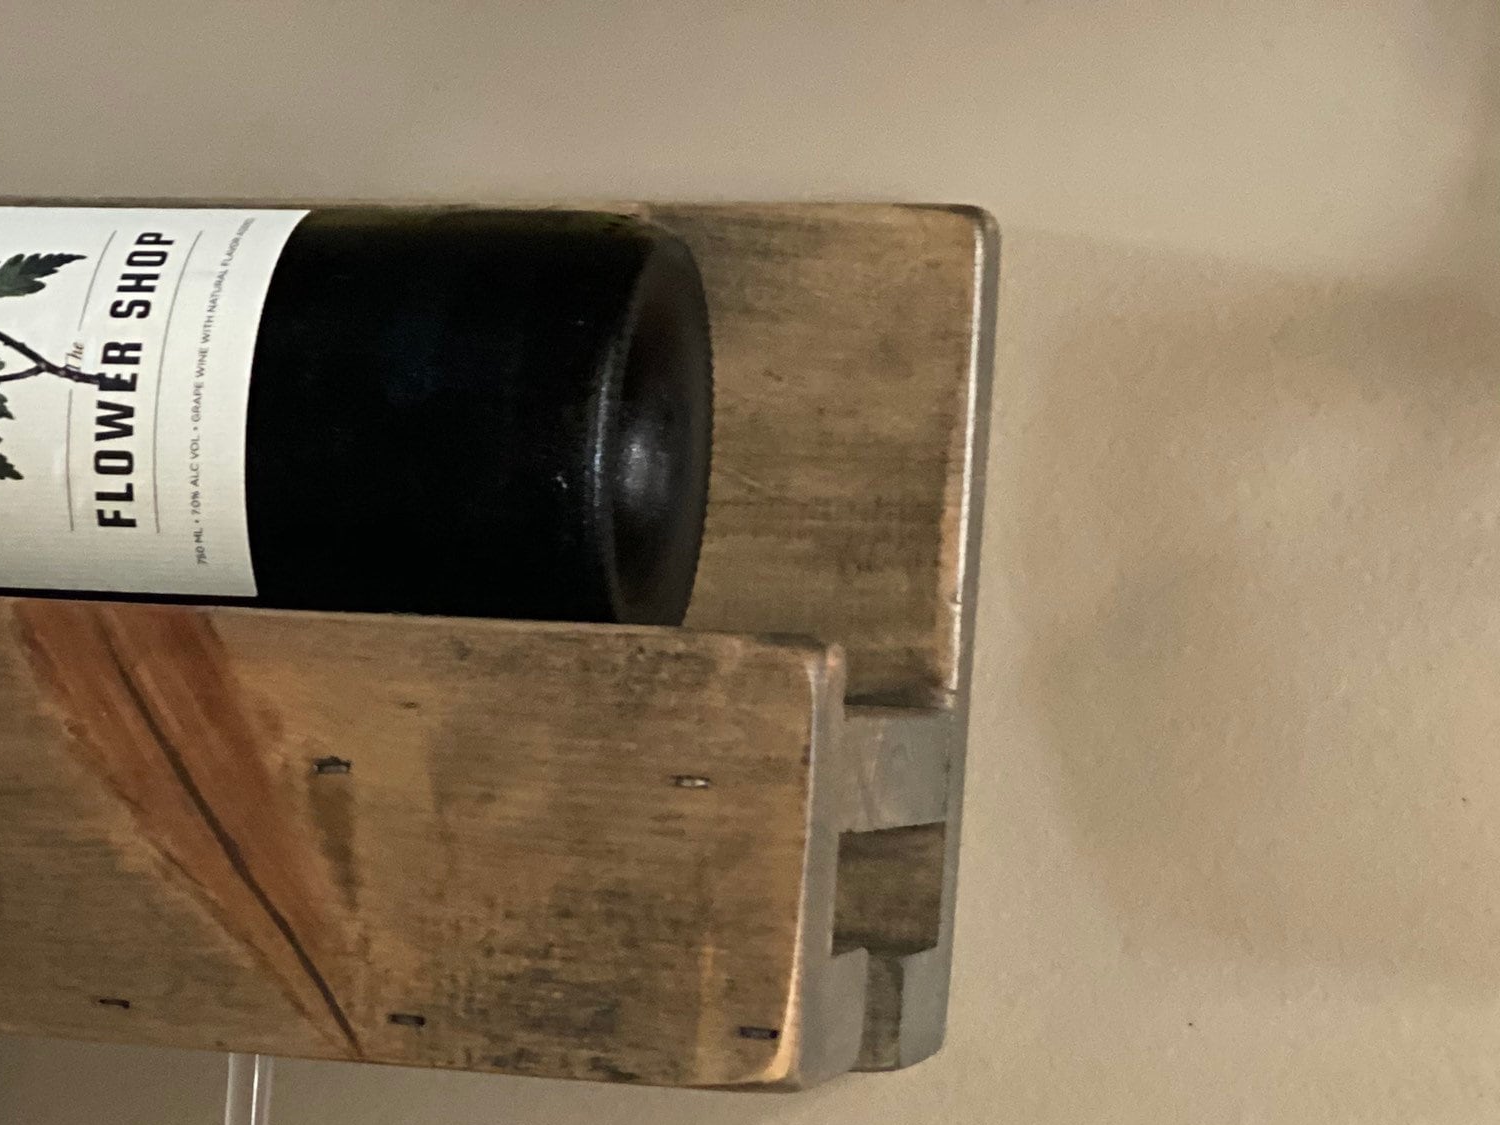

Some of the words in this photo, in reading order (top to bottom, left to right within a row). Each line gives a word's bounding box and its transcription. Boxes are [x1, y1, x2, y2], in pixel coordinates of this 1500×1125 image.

[109, 231, 175, 320] SHOP
[206, 269, 229, 313] NATURAL
[199, 314, 216, 345] WITH
[64, 341, 85, 372] The
[194, 345, 210, 378] WINE
[190, 380, 205, 423] GRAPE
[94, 341, 143, 529] FLOWER
[189, 434, 200, 460] VOL
[189, 461, 200, 488] ALC
[193, 526, 204, 543] ML
